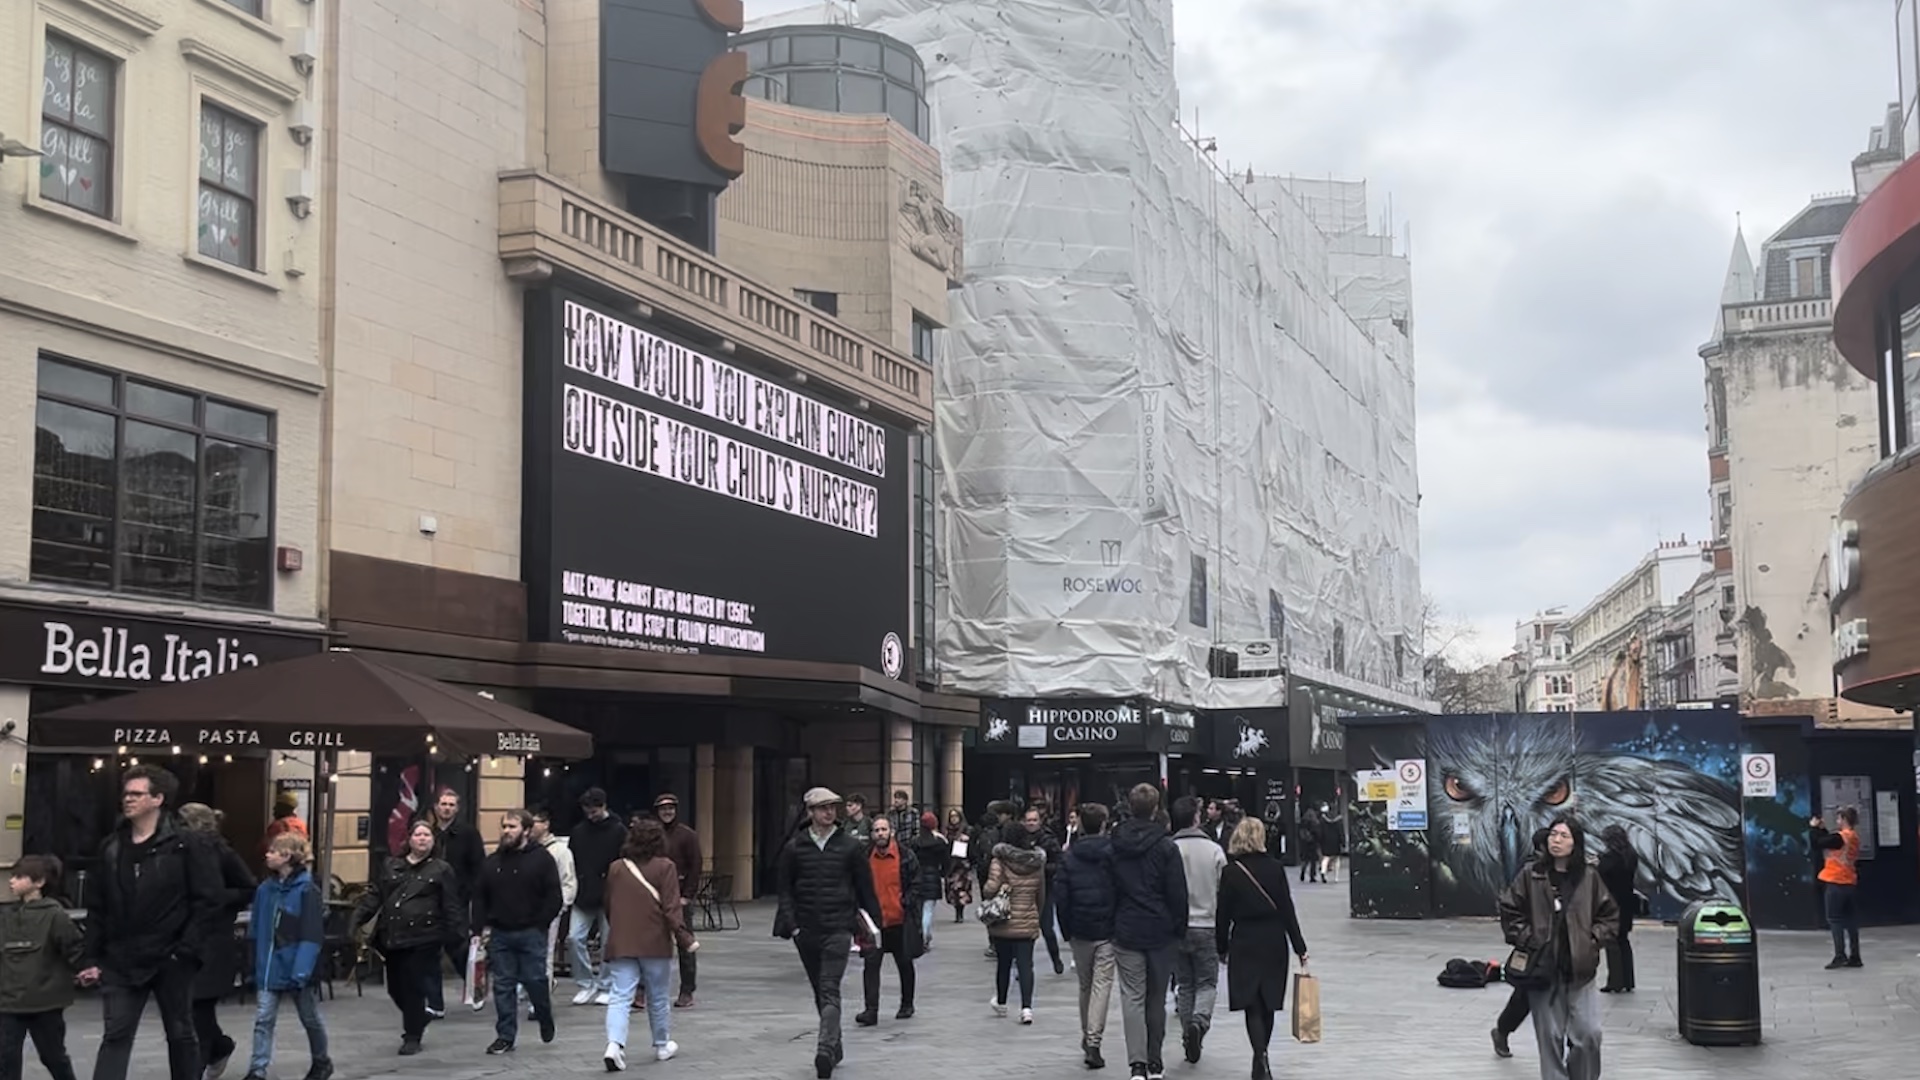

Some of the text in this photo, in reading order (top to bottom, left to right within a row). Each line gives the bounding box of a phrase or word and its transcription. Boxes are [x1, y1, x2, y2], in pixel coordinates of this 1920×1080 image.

[566, 303, 885, 475] HOW WOULD YOU EXPLAIN GUARDS
[566, 387, 877, 535] OUTSIDE YOUR CHILD'S NURSERY?
[1144, 412, 1155, 508] ROSEWOOD
[562, 570, 585, 597] HATE
[653, 587, 675, 612] JEWS
[676, 590, 691, 614] HAS
[610, 608, 625, 632] WE
[626, 611, 643, 635] CAN
[644, 613, 666, 638] STOP
[677, 619, 708, 644] FOLLOW
[41, 621, 151, 681] Bella
[1028, 707, 1141, 724] HIPPODROME
[114, 728, 345, 747] PIZZA PASTA GRILL
[497, 731, 521, 751] Bella
[1053, 726, 1118, 741] CASINO
[1407, 768, 1414, 777] 5
[1755, 763, 1762, 772] 5
